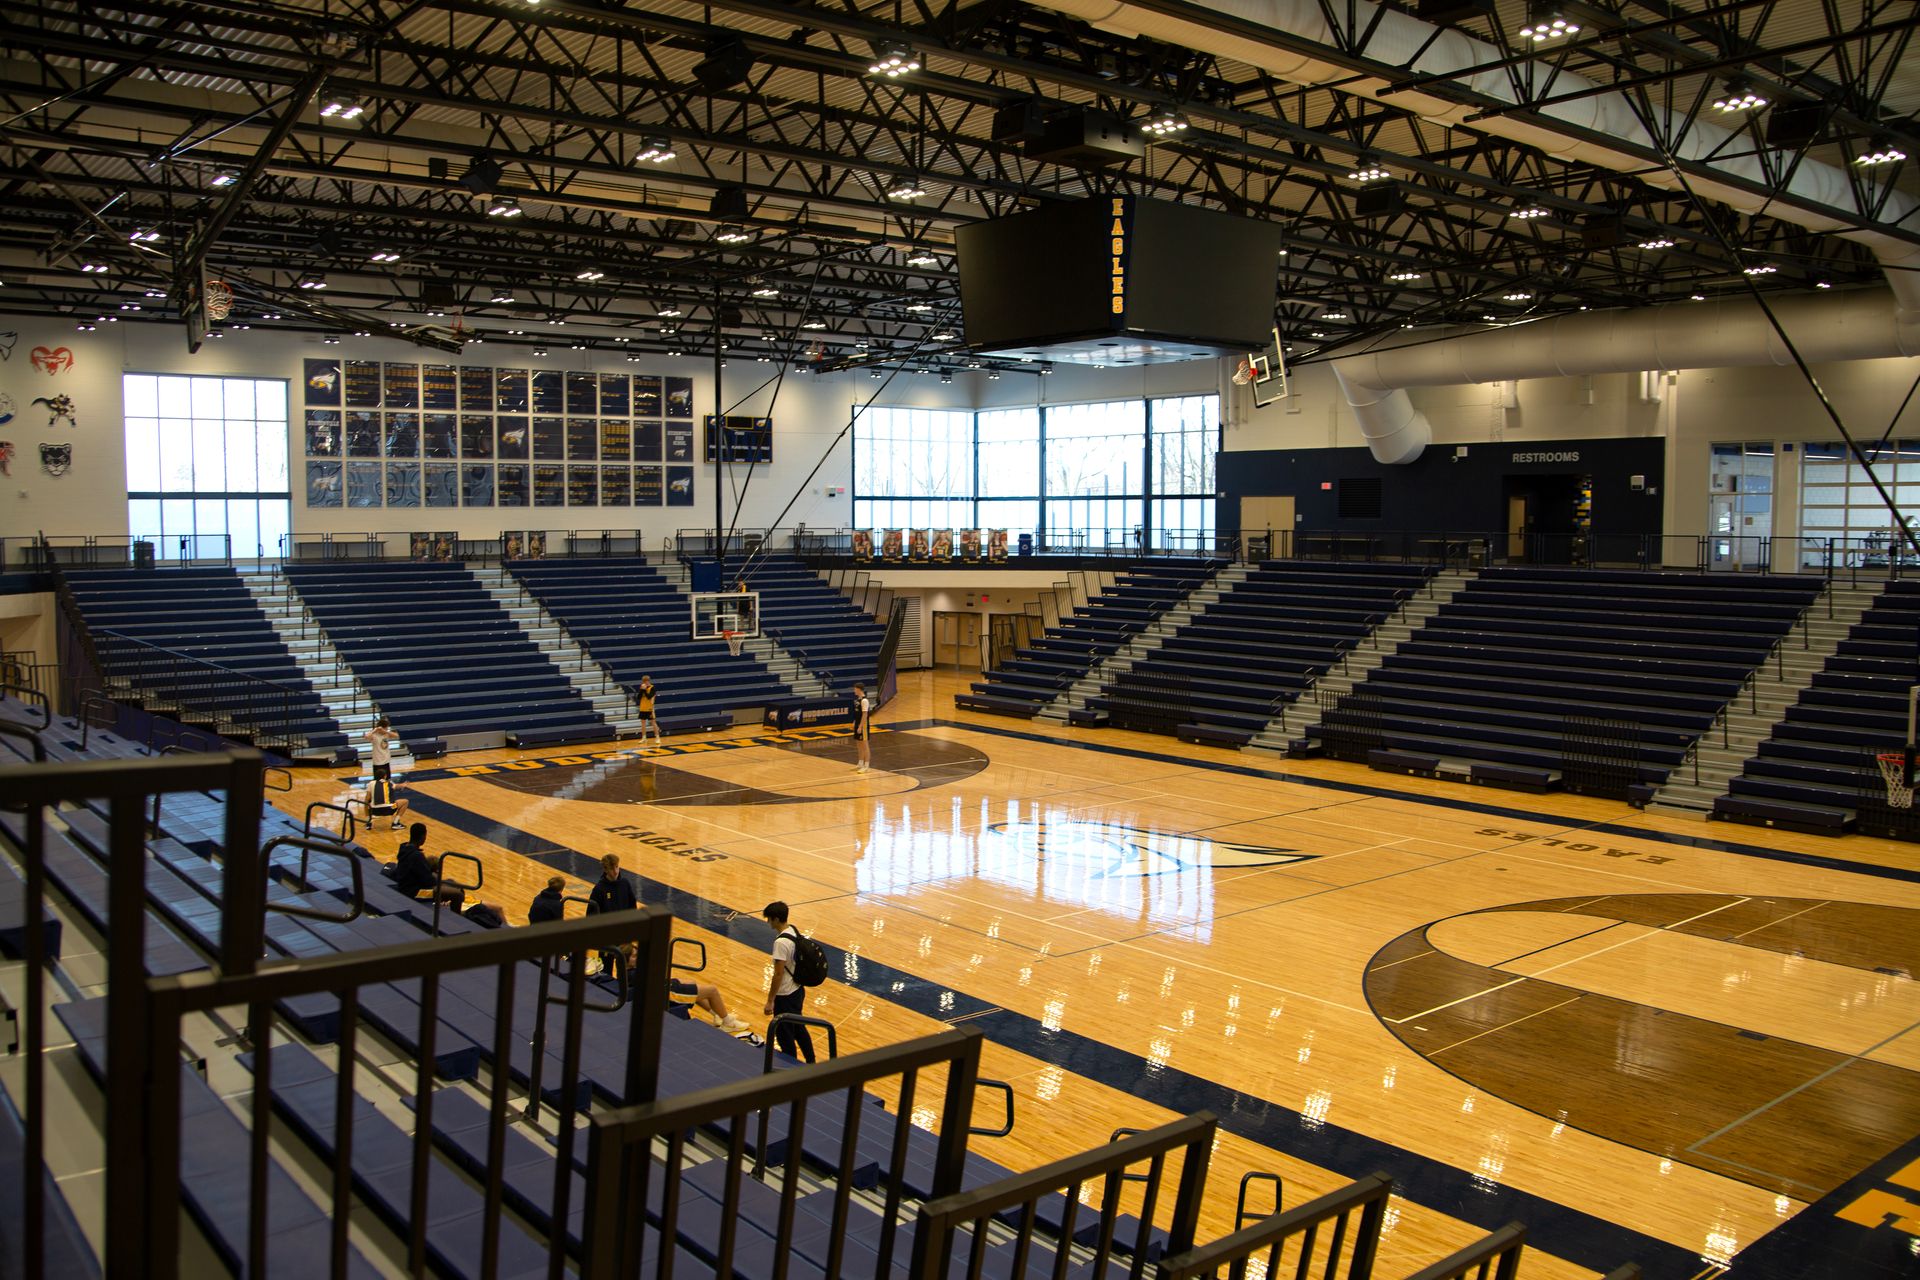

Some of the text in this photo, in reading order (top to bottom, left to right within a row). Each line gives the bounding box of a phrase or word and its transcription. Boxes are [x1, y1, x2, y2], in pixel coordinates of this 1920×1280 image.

[1111, 198, 1125, 314] EAGLES
[1512, 451, 1580, 463] RESTROOMS
[802, 707, 848, 718] HUDSONVILLE
[603, 825, 728, 862] EAGLES
[1474, 828, 1676, 865] EAGLES
